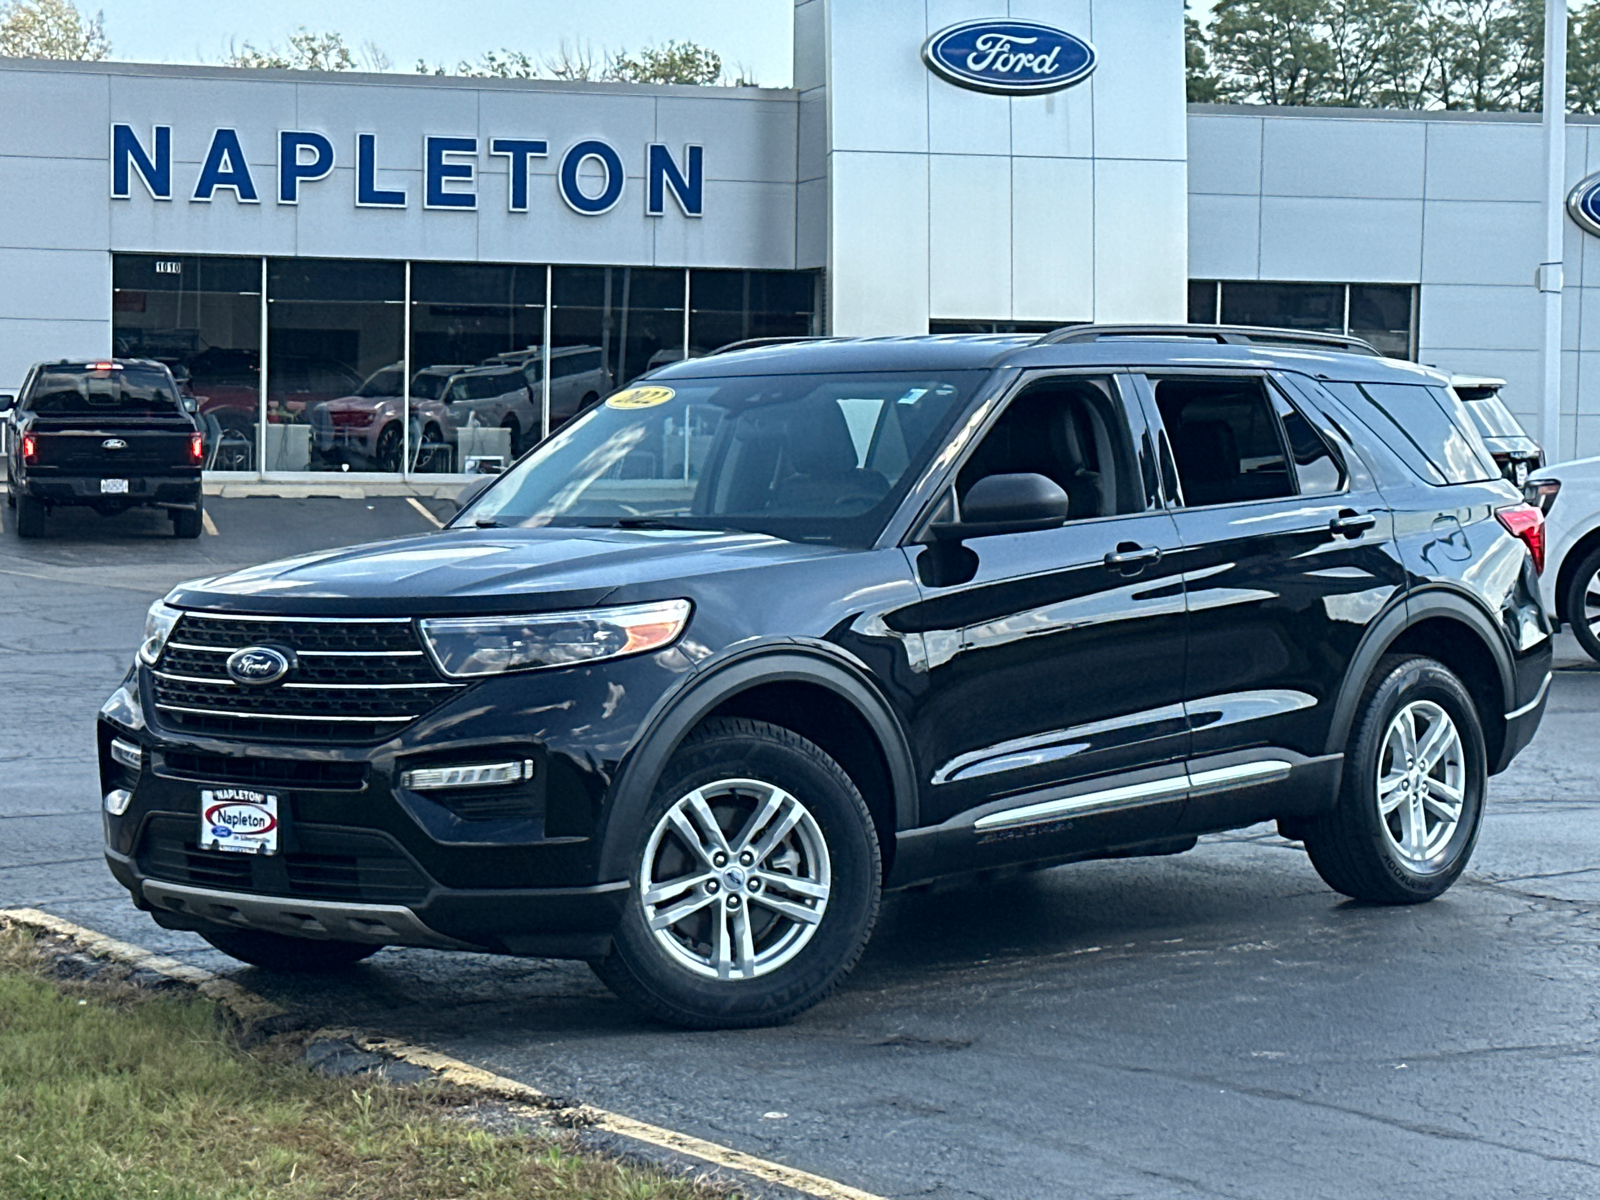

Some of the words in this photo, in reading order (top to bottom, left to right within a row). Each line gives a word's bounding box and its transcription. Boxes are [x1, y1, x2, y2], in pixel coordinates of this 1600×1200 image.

[967, 33, 1062, 75] Ford
[110, 122, 704, 218] NAPLETON
[156, 261, 181, 274] 1010
[614, 390, 669, 404] 2022
[238, 654, 272, 674] Ford
[216, 789, 264, 804] NAPLETON
[217, 808, 266, 828] Napleton
